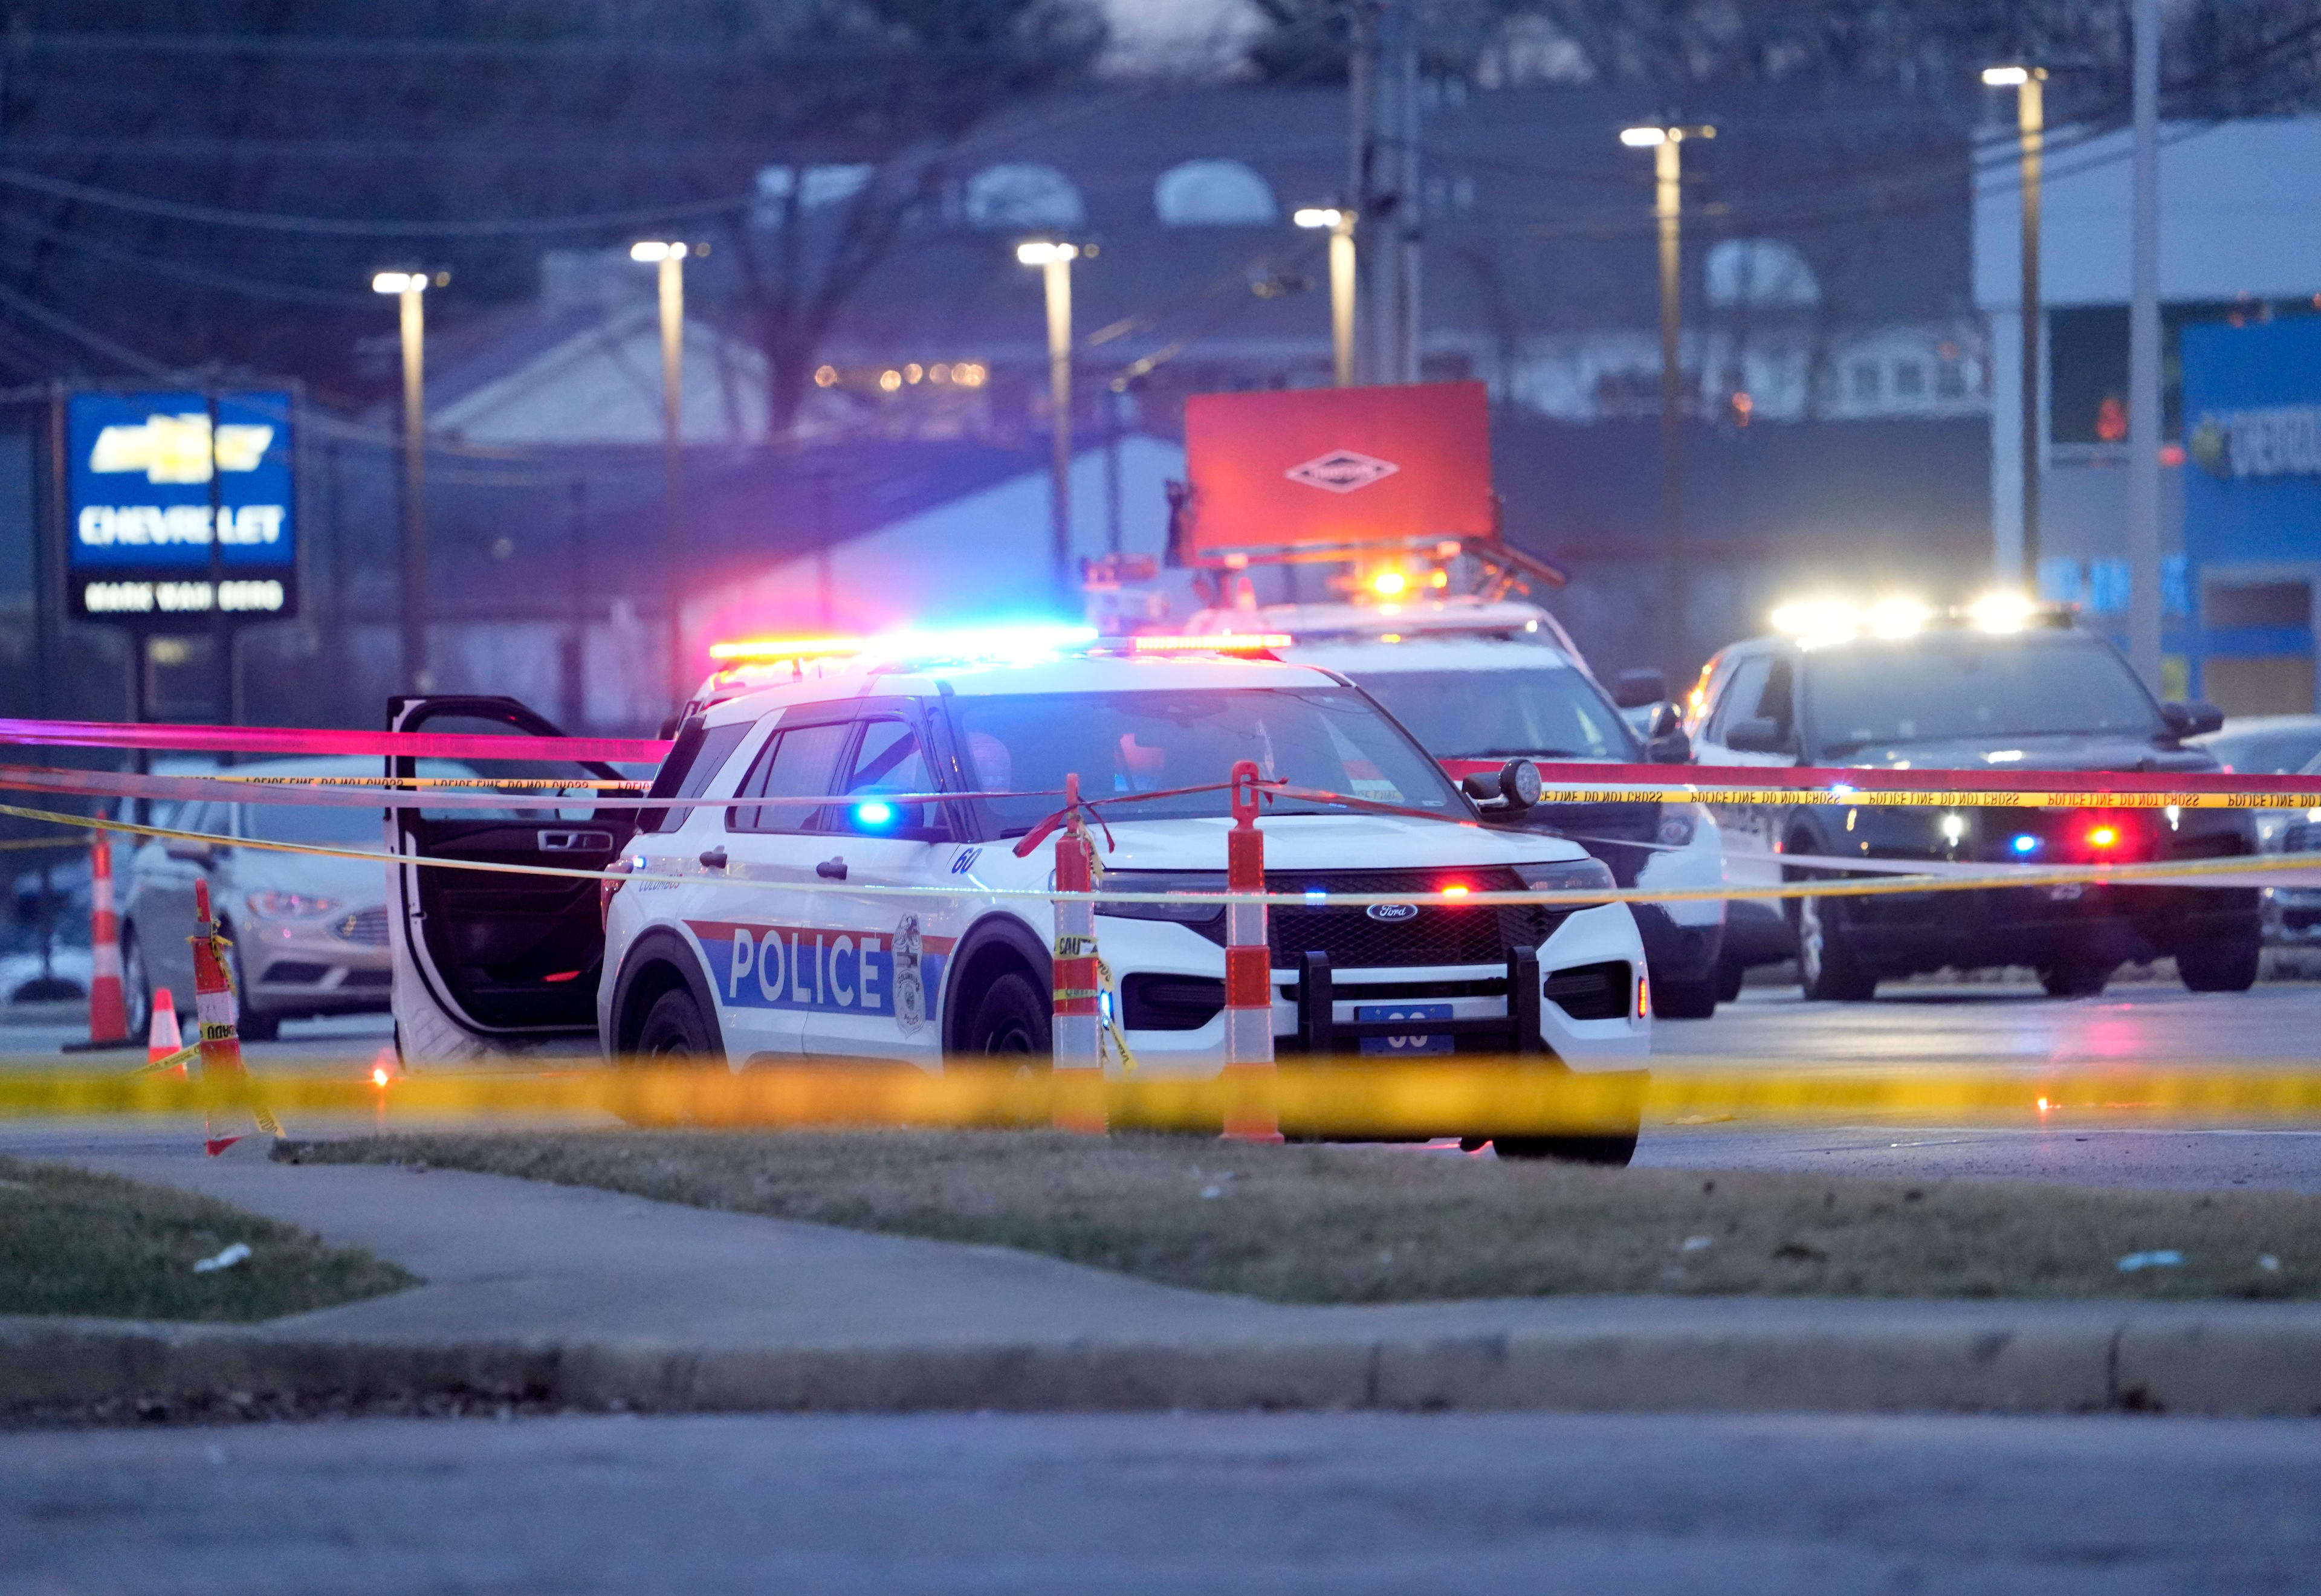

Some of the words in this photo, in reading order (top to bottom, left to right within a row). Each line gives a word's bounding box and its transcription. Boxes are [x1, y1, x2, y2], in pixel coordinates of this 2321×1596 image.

[951, 847, 982, 874] 60
[1379, 904, 1407, 917] Ford
[729, 928, 881, 1008] POLICE
